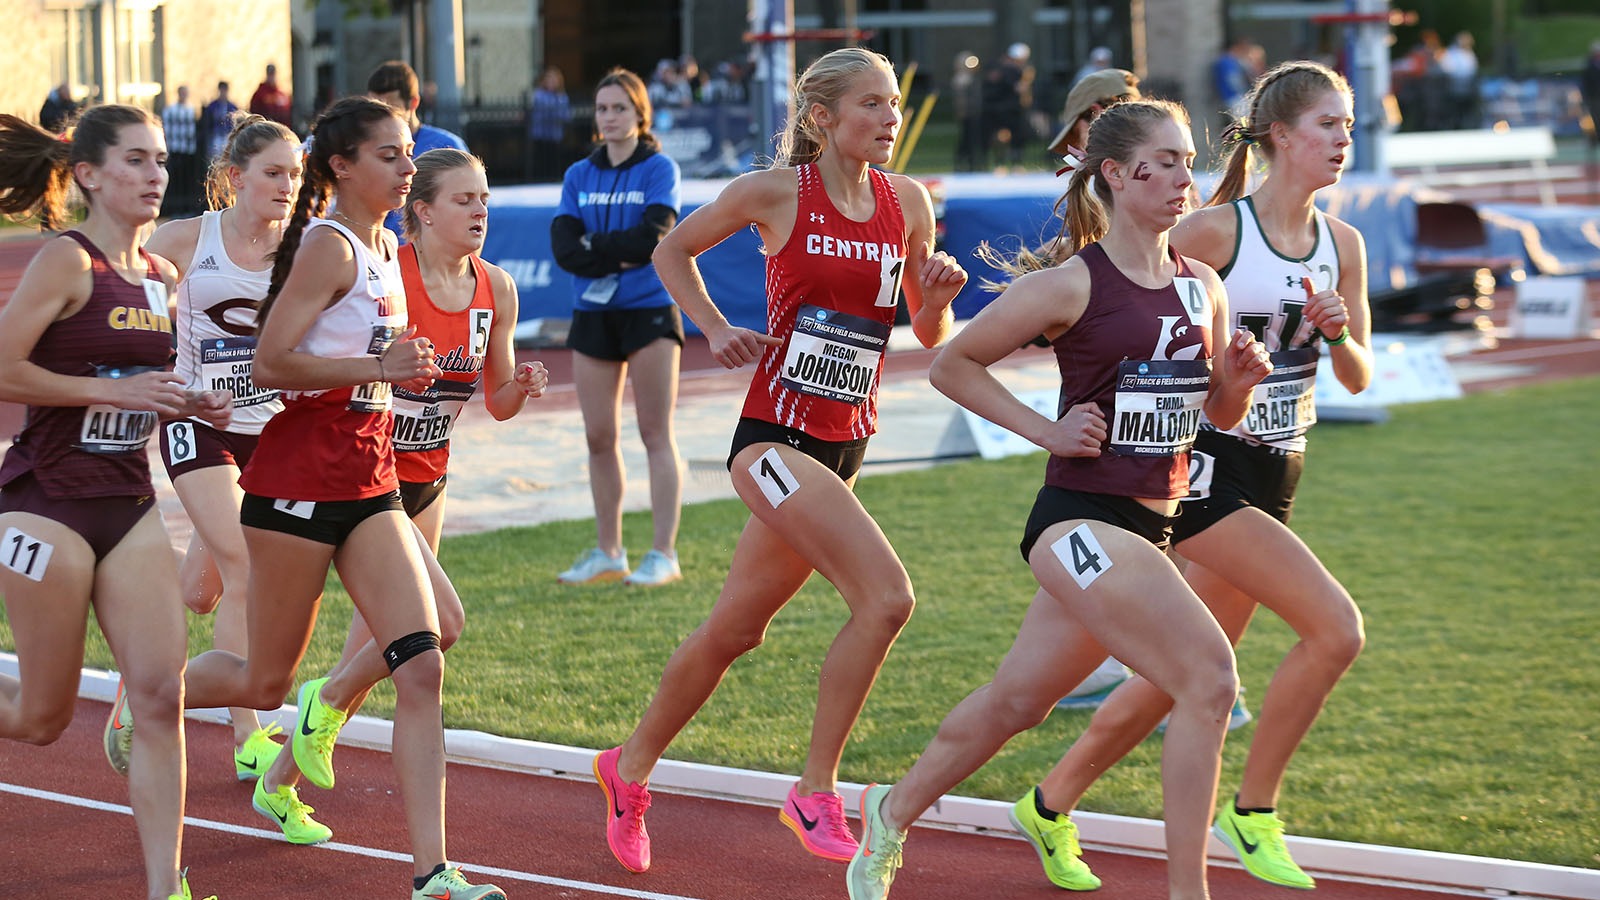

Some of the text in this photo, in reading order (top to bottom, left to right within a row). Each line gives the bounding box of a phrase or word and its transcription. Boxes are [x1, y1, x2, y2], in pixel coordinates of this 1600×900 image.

[889, 262, 902, 305] 1
[475, 312, 488, 353] 5
[813, 322, 832, 333] TRACK
[834, 328, 848, 337] FIELD
[848, 331, 885, 345] CHAMPIONSHIPS
[231, 363, 253, 375] CAIT
[822, 343, 858, 361] MEGAN
[211, 375, 273, 399] JORGE
[788, 352, 873, 395] JOHNSON
[1136, 378, 1156, 386] TRACK
[1161, 378, 1174, 386] FIELD
[423, 404, 440, 417] ELLE
[1156, 396, 1185, 410] EMMA
[1247, 394, 1312, 432] CRABT
[87, 412, 156, 441] ALLM
[172, 423, 190, 460] 8
[392, 414, 451, 442] MEYER
[1118, 408, 1201, 443] MALOOLY
[761, 457, 790, 496] 1
[1189, 452, 1205, 497] 2
[10, 534, 41, 575] 11
[1069, 532, 1102, 576] 4
